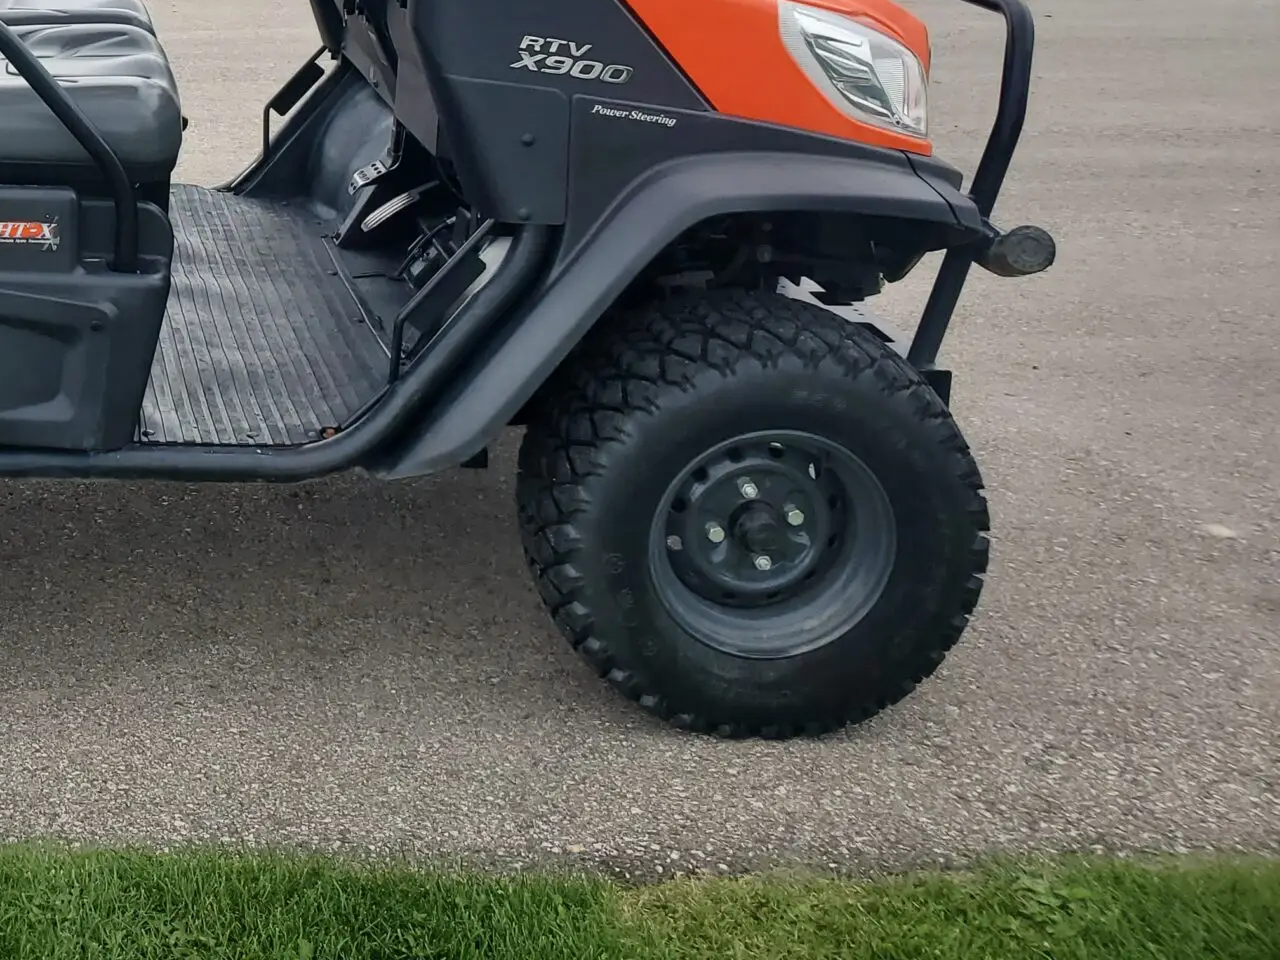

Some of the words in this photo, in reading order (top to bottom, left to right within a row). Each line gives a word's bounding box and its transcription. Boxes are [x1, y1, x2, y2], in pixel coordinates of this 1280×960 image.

[519, 35, 593, 57] RTV
[509, 51, 634, 84] X900
[591, 104, 628, 119] Power
[629, 110, 677, 127] Steering
